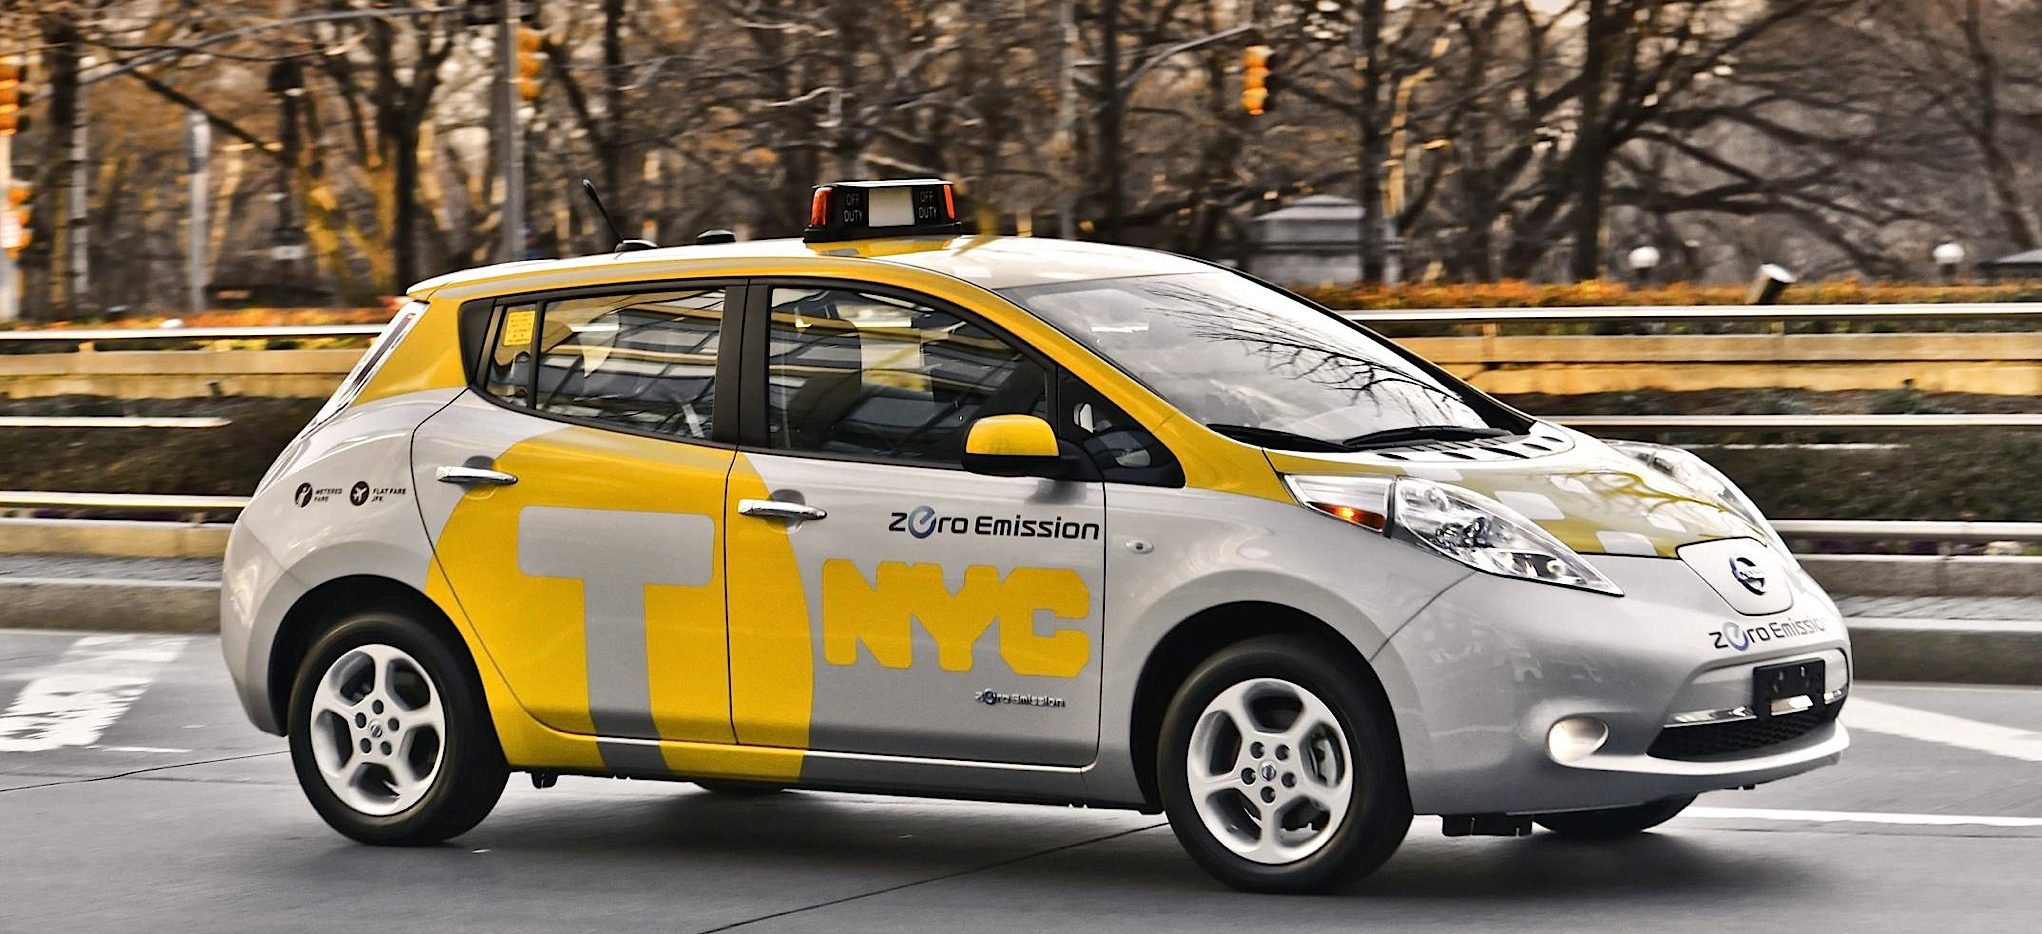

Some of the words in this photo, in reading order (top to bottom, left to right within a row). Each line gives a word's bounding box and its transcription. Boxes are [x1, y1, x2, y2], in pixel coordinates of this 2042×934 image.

[846, 194, 860, 206] OFF
[920, 191, 933, 203] OFF
[844, 209, 863, 222] DUTY
[919, 207, 937, 219] DUTY
[974, 514, 1100, 540] Emission
[822, 558, 1091, 679] NYC
[1769, 615, 1826, 638] Emissio
[518, 506, 716, 777] T
